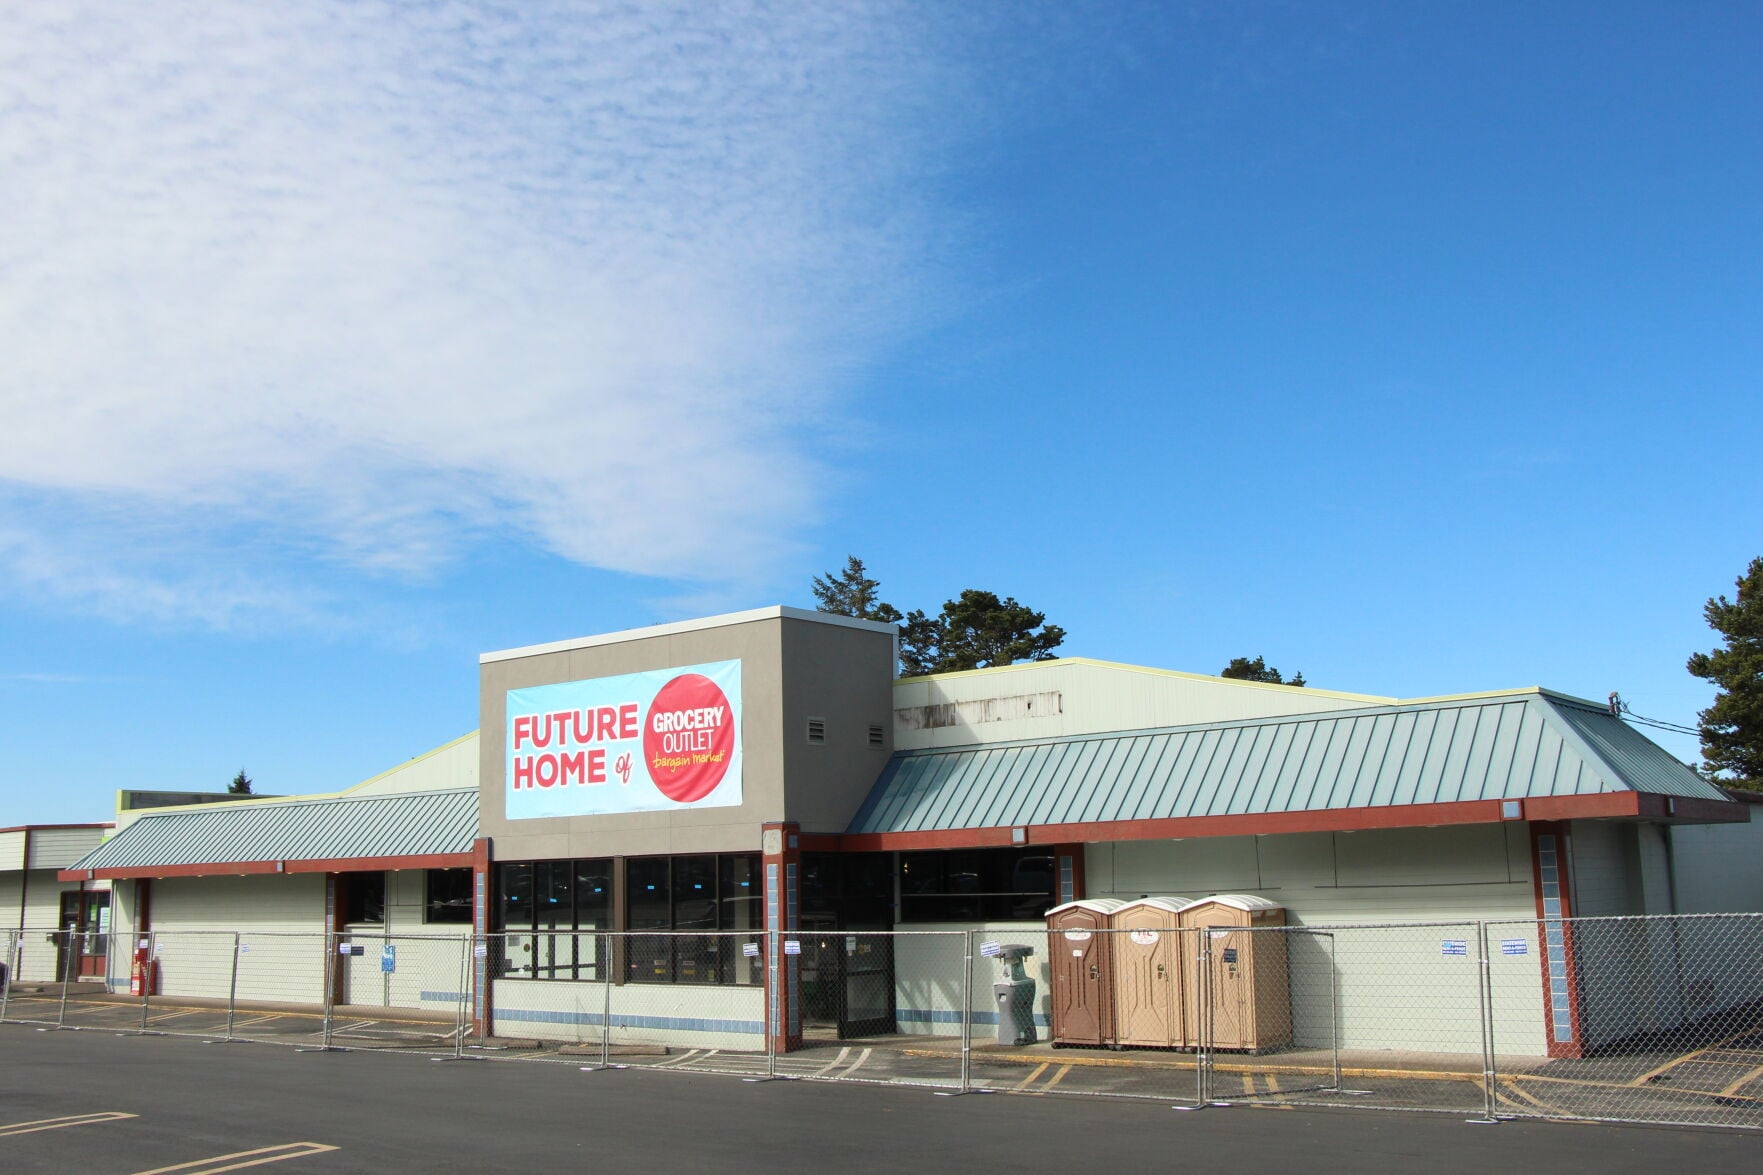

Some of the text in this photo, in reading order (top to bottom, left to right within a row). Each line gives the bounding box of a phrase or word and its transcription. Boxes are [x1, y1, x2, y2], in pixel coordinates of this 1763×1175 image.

[514, 704, 639, 750] FUTURE
[653, 706, 724, 733] GROCERY
[663, 729, 714, 753] OUTLET
[514, 749, 632, 789] HOME of
[652, 749, 725, 773] bargain market
